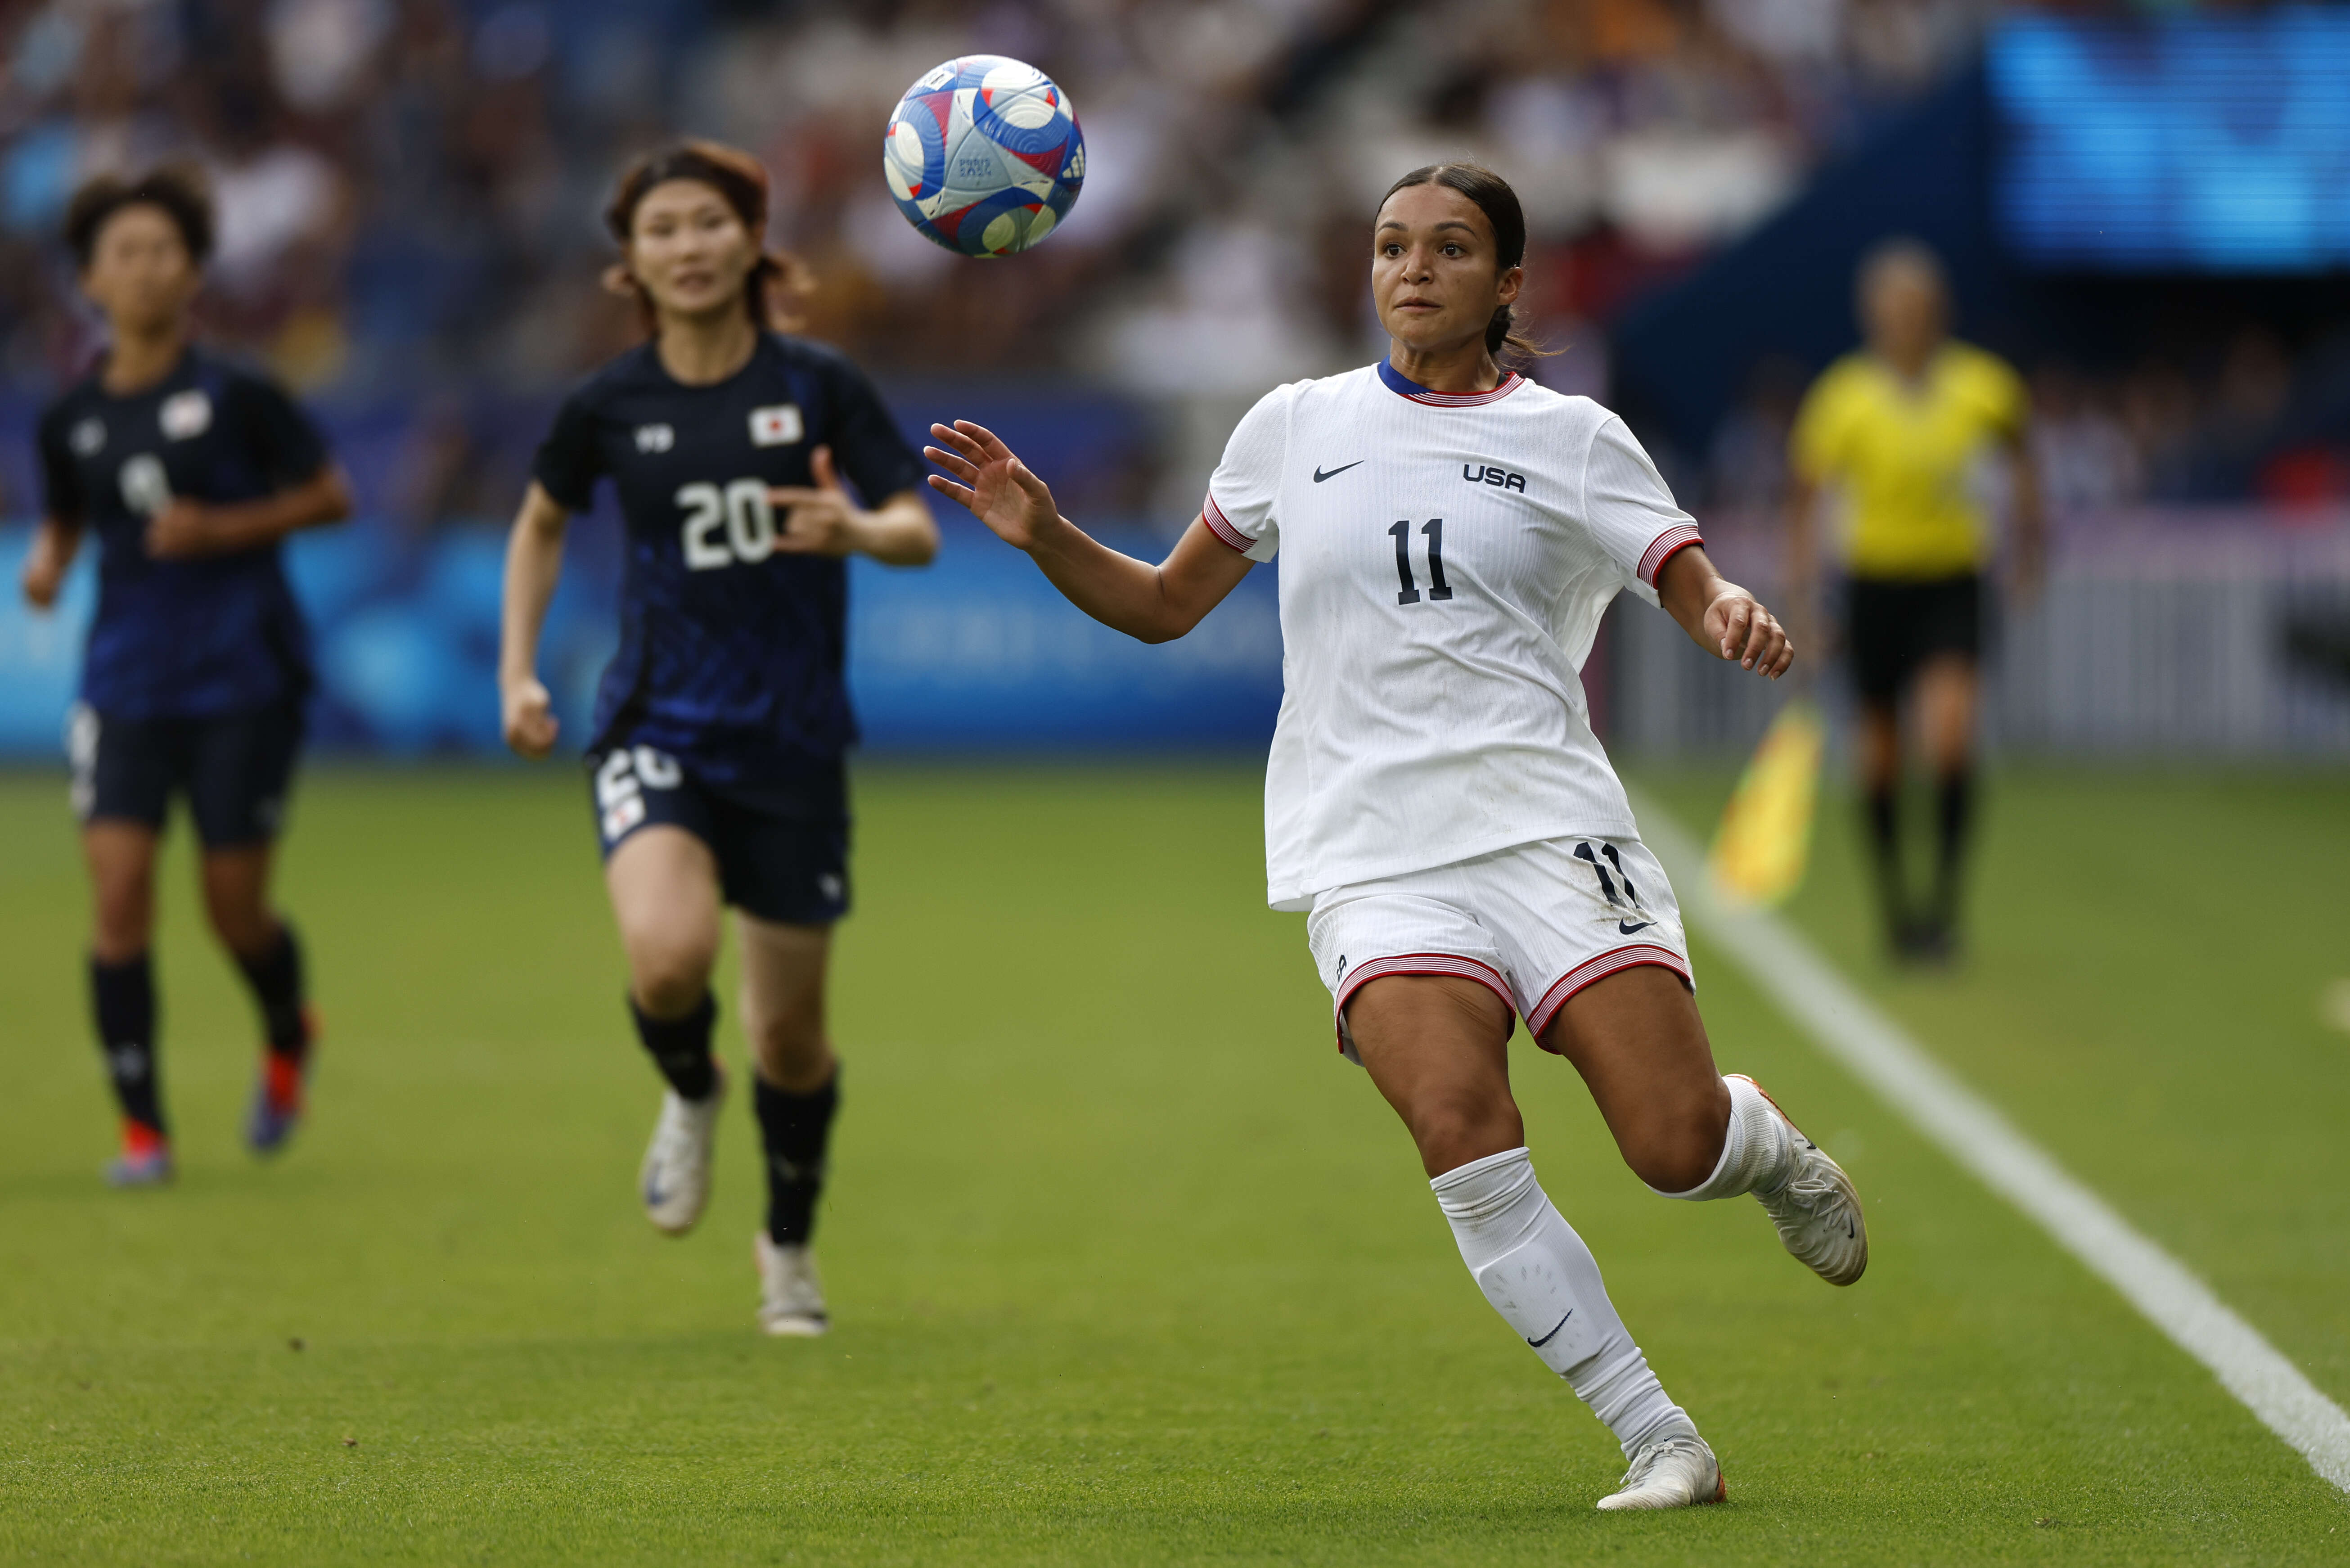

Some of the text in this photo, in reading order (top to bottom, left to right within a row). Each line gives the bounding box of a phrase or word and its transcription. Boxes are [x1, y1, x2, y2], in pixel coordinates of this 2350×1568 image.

[1463, 464, 1526, 493] USA
[675, 477, 776, 571] 20
[1388, 518, 1452, 605] 11
[1573, 841, 1645, 911] 11
